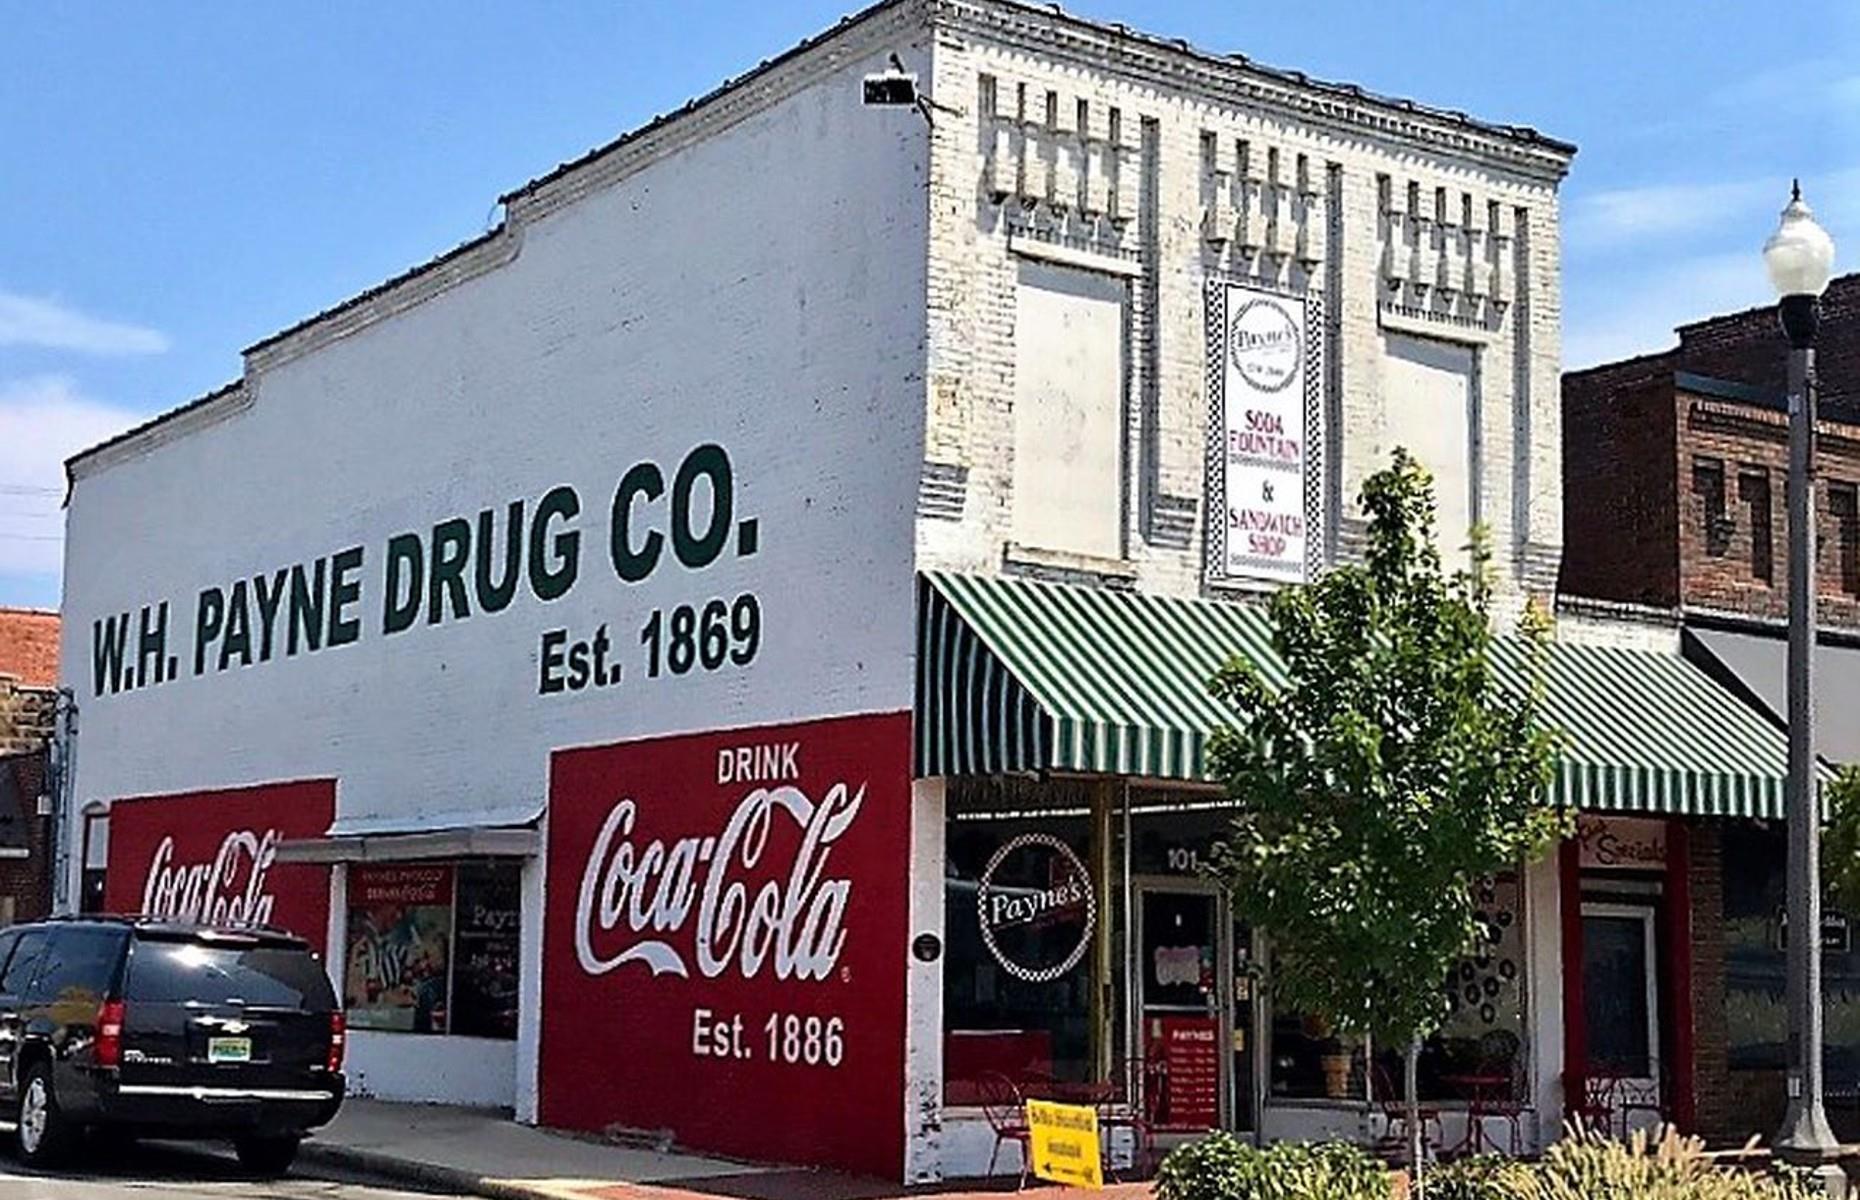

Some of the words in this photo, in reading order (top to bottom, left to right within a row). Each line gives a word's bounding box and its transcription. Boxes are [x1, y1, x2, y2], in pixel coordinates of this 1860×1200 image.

[1244, 409, 1284, 435] SODA
[1229, 430, 1299, 459] FOUNTAIN
[1262, 480, 1275, 502] &
[1229, 508, 1303, 538] SANDWICH
[1248, 533, 1286, 557] SHOP
[94, 600, 178, 697] W.H.
[195, 546, 364, 675] PAYNE
[383, 486, 581, 634] DRUG
[611, 443, 759, 583] CO.
[538, 630, 620, 695] Est.
[641, 594, 761, 678] 1869
[718, 743, 800, 784] DRINK
[576, 781, 868, 980] Coca-Cola
[992, 875, 1082, 924] Payne's
[693, 1009, 752, 1058] Est.
[764, 1012, 843, 1066] 1886
